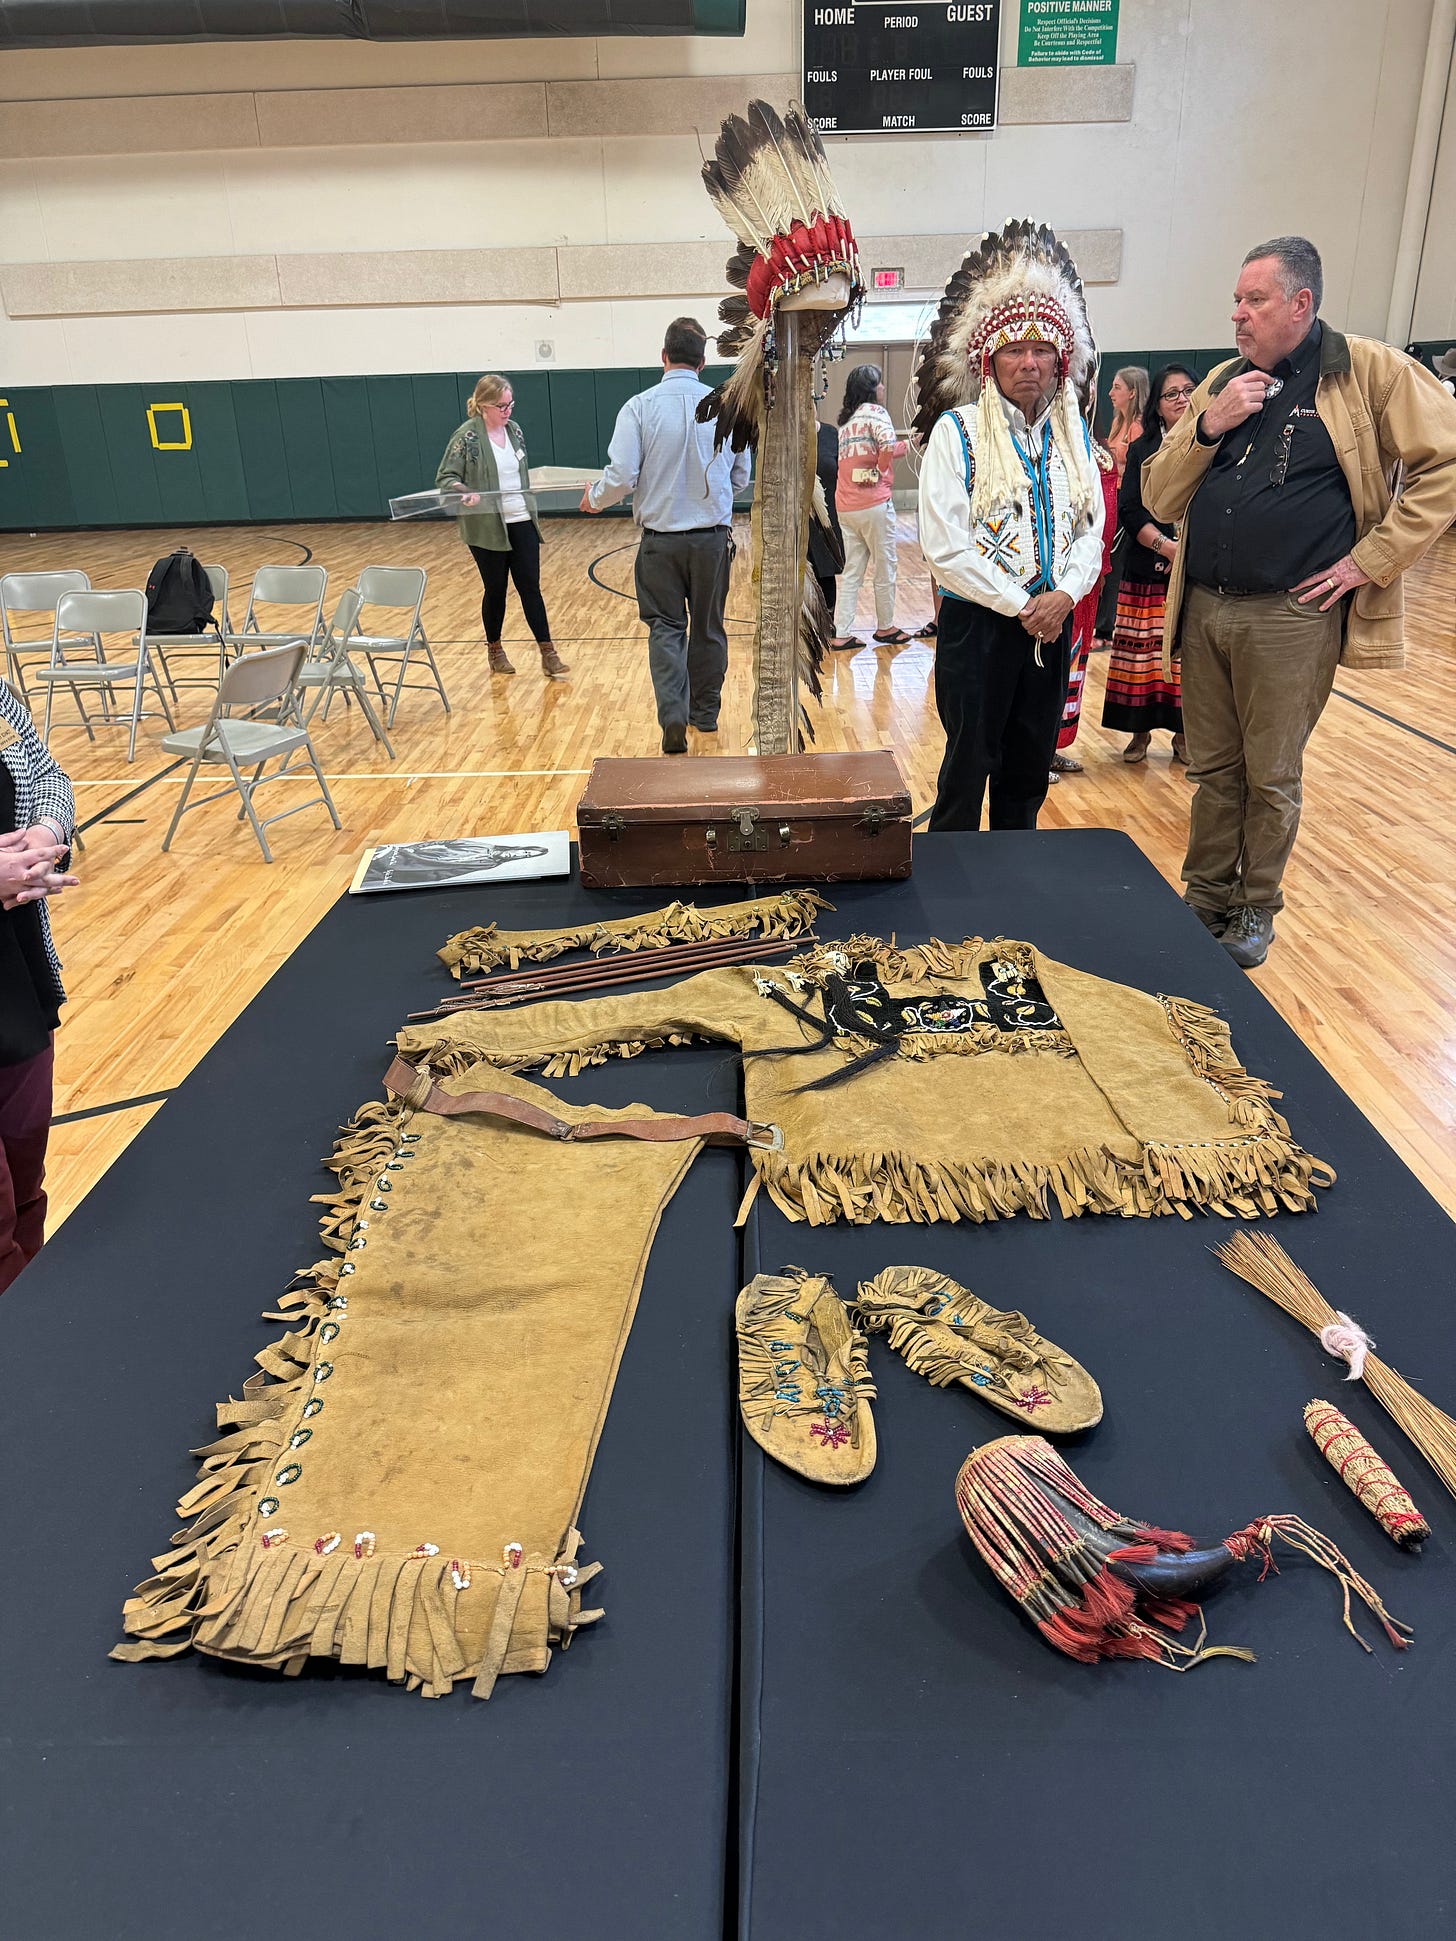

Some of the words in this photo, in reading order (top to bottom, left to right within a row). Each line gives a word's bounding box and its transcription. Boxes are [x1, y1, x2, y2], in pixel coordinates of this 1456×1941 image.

[1028, 1, 1070, 13] POSITIVE
[1072, 0, 1111, 11] MANNER
[814, 8, 855, 25] HOME
[947, 5, 993, 22] GUEST
[884, 16, 918, 28] PERIOD
[807, 70, 837, 82] FOULS
[870, 69, 906, 81] PLAYER
[909, 68, 932, 80] FOUL
[962, 67, 993, 79] FOULS
[808, 117, 837, 128] SCORE
[882, 116, 915, 127] MATCH
[961, 113, 991, 125] SCORE
